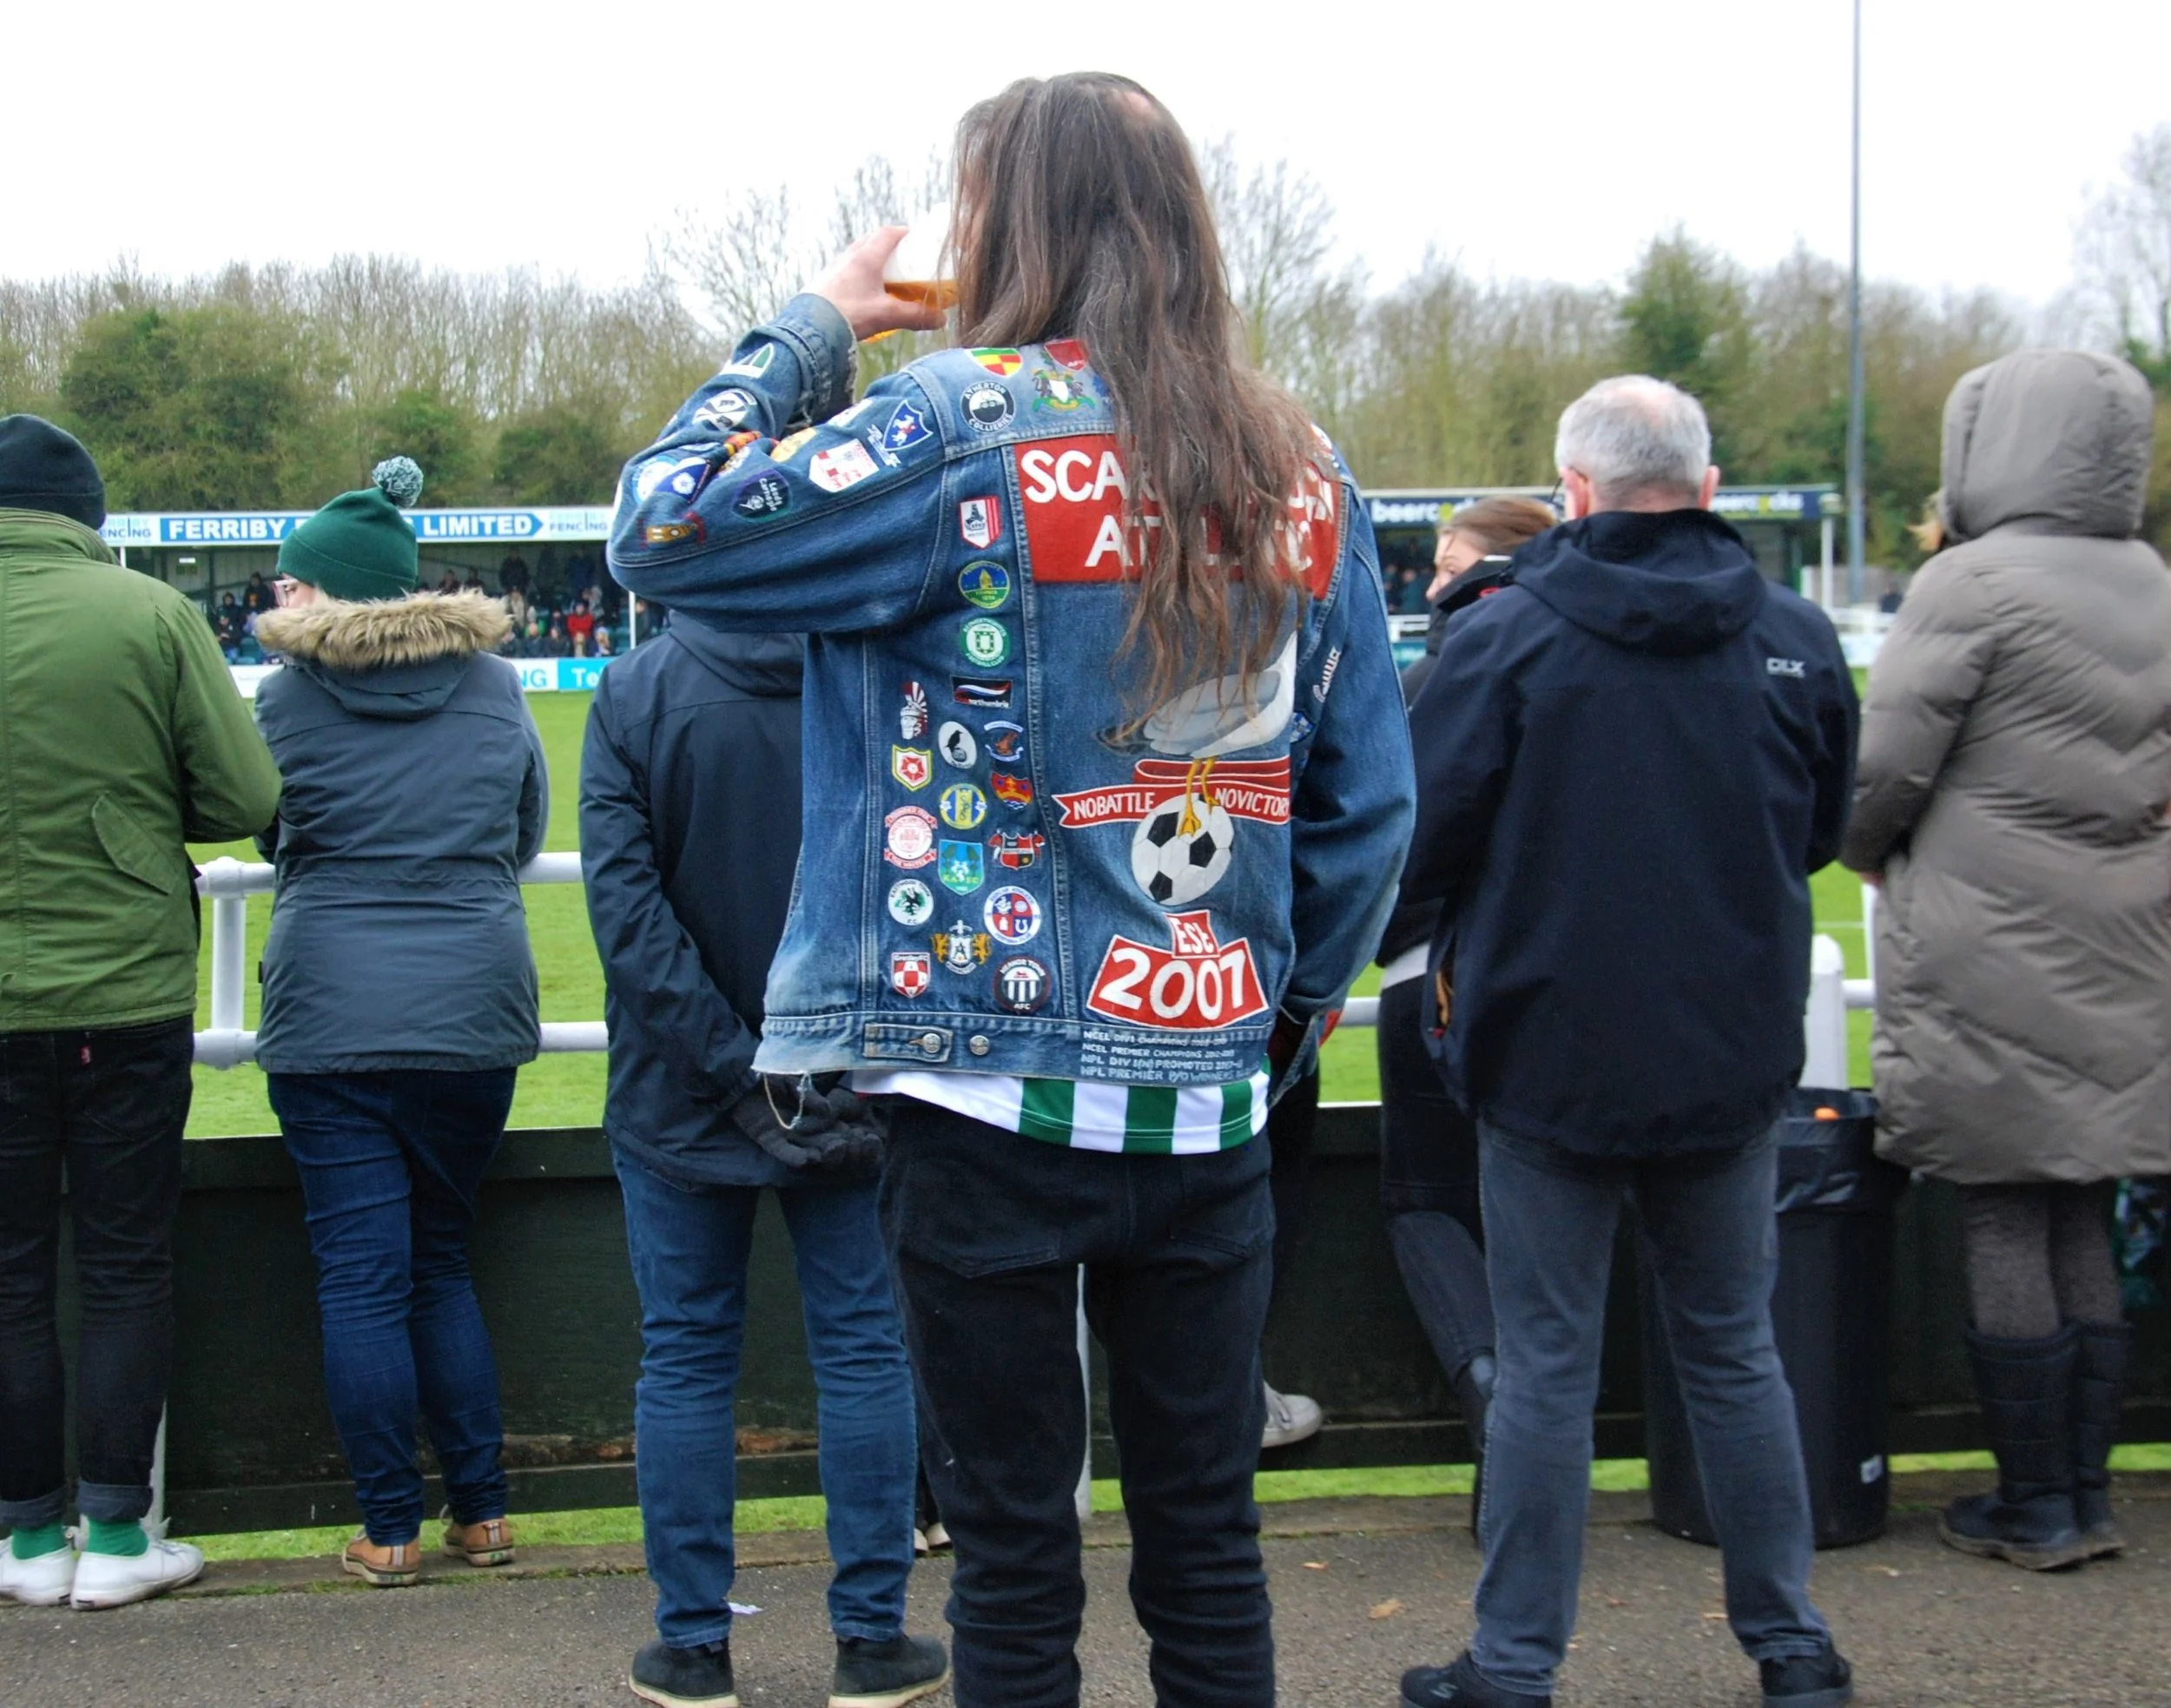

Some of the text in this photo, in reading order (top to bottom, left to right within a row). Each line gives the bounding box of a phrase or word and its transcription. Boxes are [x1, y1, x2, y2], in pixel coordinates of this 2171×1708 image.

[964, 382, 1006, 399] ATHERTON
[99, 527, 151, 537] ENCING
[169, 519, 287, 539] FERRIBY
[424, 515, 532, 536] LIMITED
[550, 521, 608, 531] FENCING
[1111, 1046, 1151, 1057] PREMIER
[1153, 1049, 1202, 1058] CHAMPIONS
[1081, 1053, 1105, 1065] NPL
[1109, 1057, 1131, 1067] DIV
[1156, 1059, 1214, 1071] PROMOTED
[1080, 1066, 1106, 1078] NPL
[1108, 1068, 1164, 1080] PREMIER
